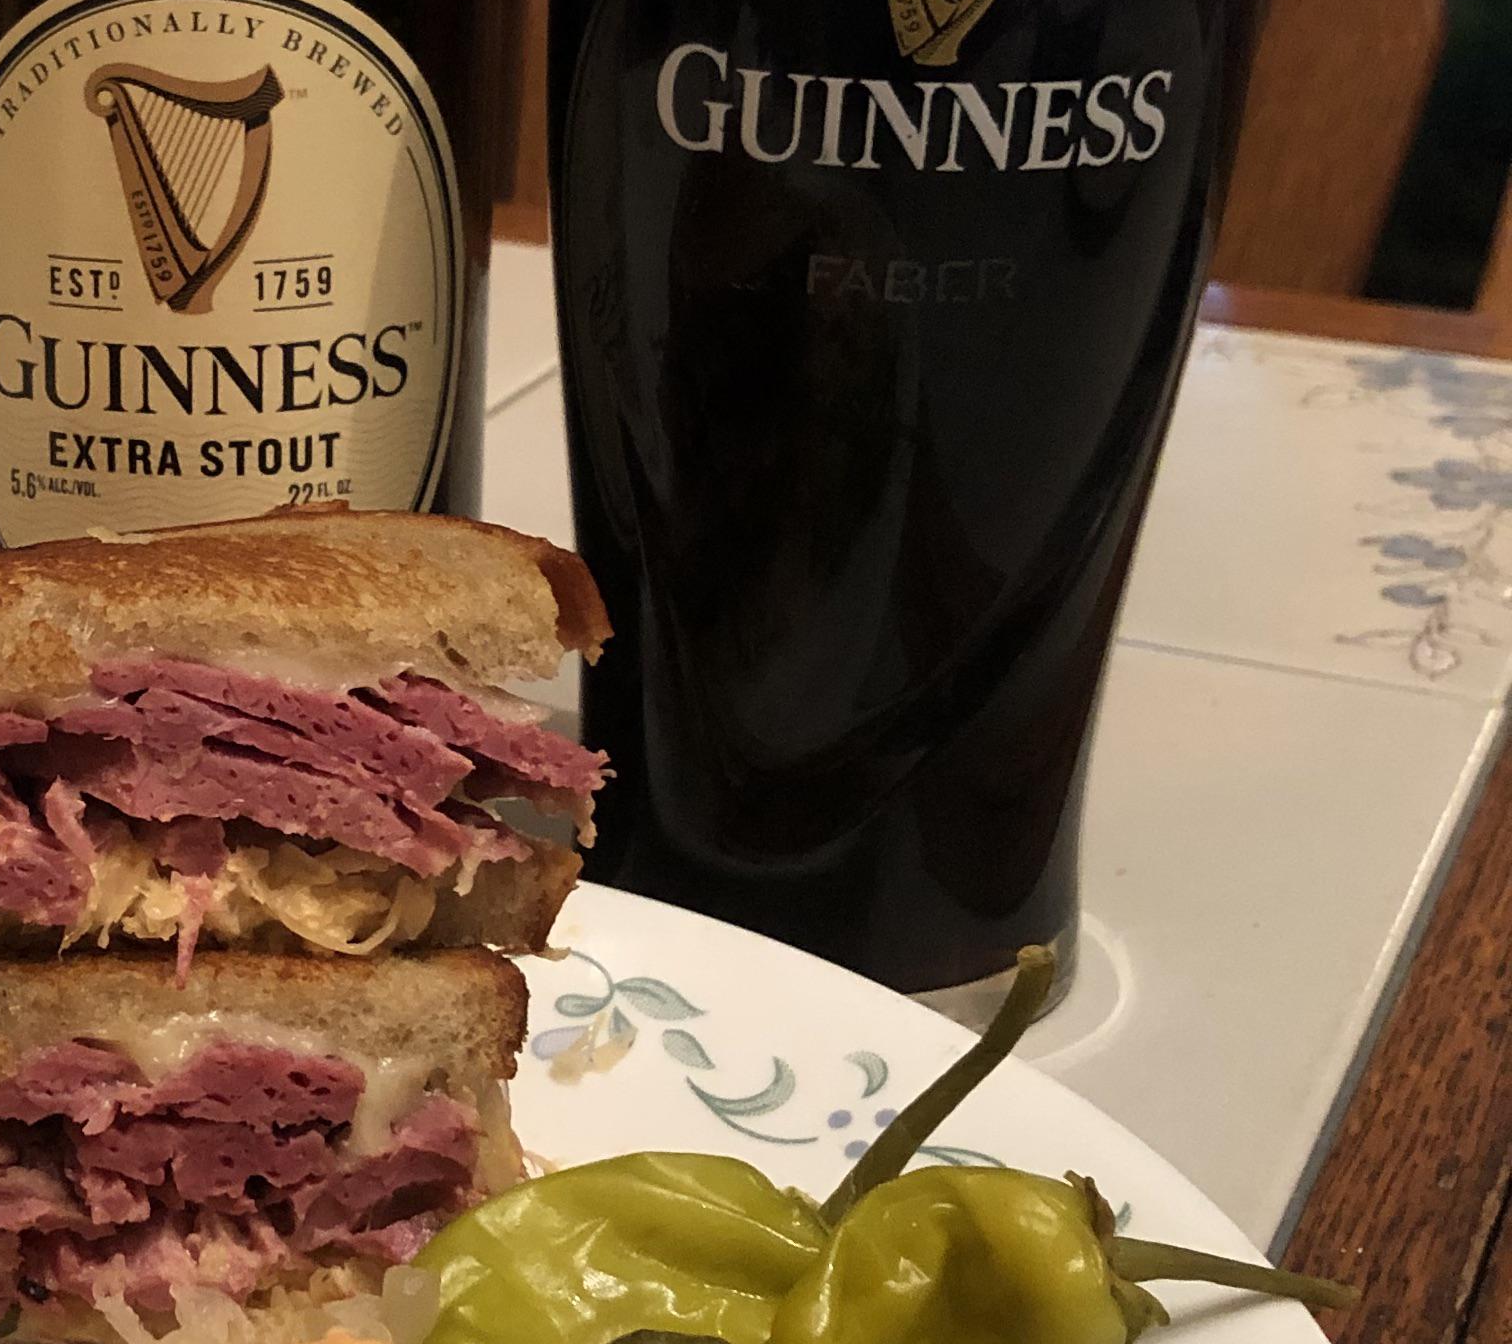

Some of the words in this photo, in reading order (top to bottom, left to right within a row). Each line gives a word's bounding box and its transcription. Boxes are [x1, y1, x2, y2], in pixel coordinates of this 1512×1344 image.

[281, 28, 404, 136] BREWED
[655, 42, 1174, 172] GUINNESS
[142, 233, 174, 282] 1759
[254, 265, 334, 301] 1759
[48, 430, 182, 477] EXTRA
[200, 431, 341, 477] STOUT
[288, 482, 314, 505] 22
